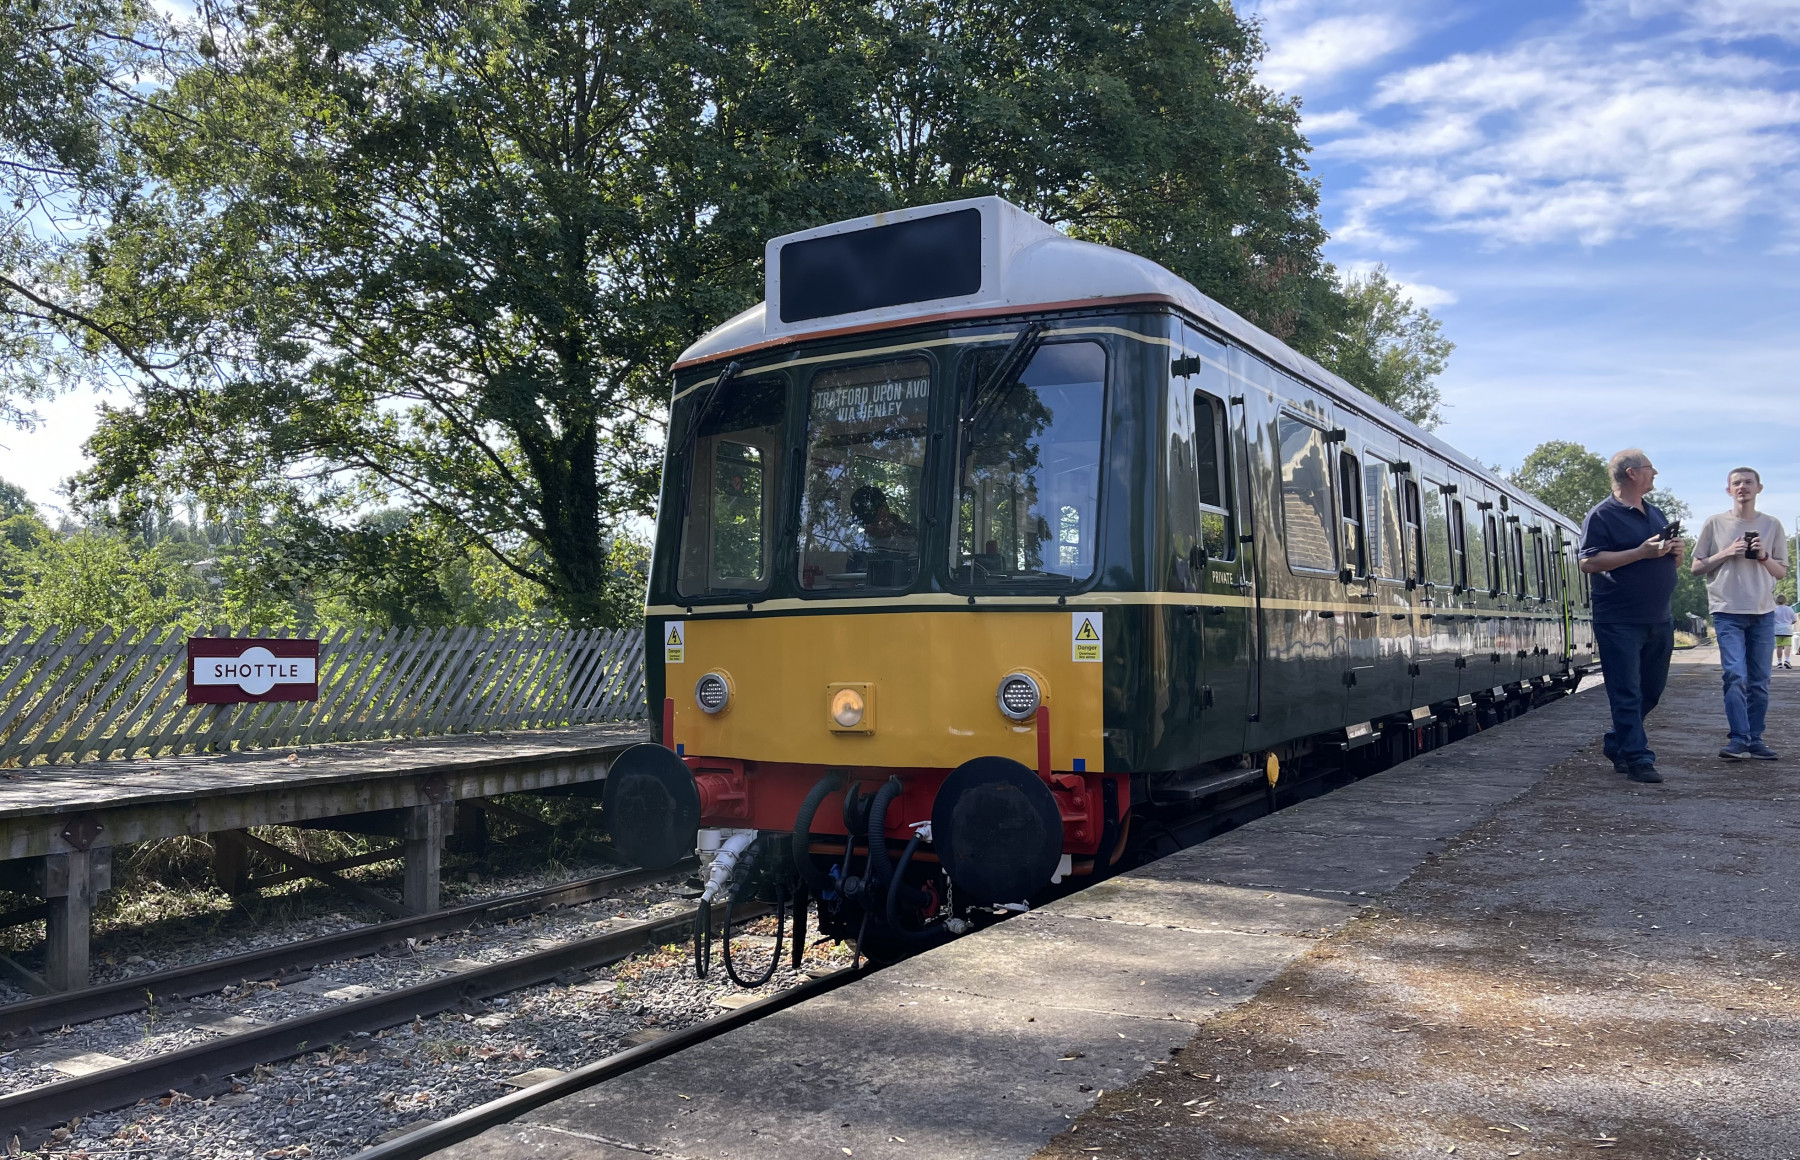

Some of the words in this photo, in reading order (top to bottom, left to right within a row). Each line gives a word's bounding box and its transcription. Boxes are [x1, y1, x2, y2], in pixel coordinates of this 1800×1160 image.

[873, 383, 902, 402] UPON
[906, 379, 930, 399] AVO
[838, 407, 855, 421] VIA
[862, 402, 902, 420] HENLEY
[1212, 570, 1233, 584] PRIVATE
[214, 664, 298, 678] SHOTTLE
